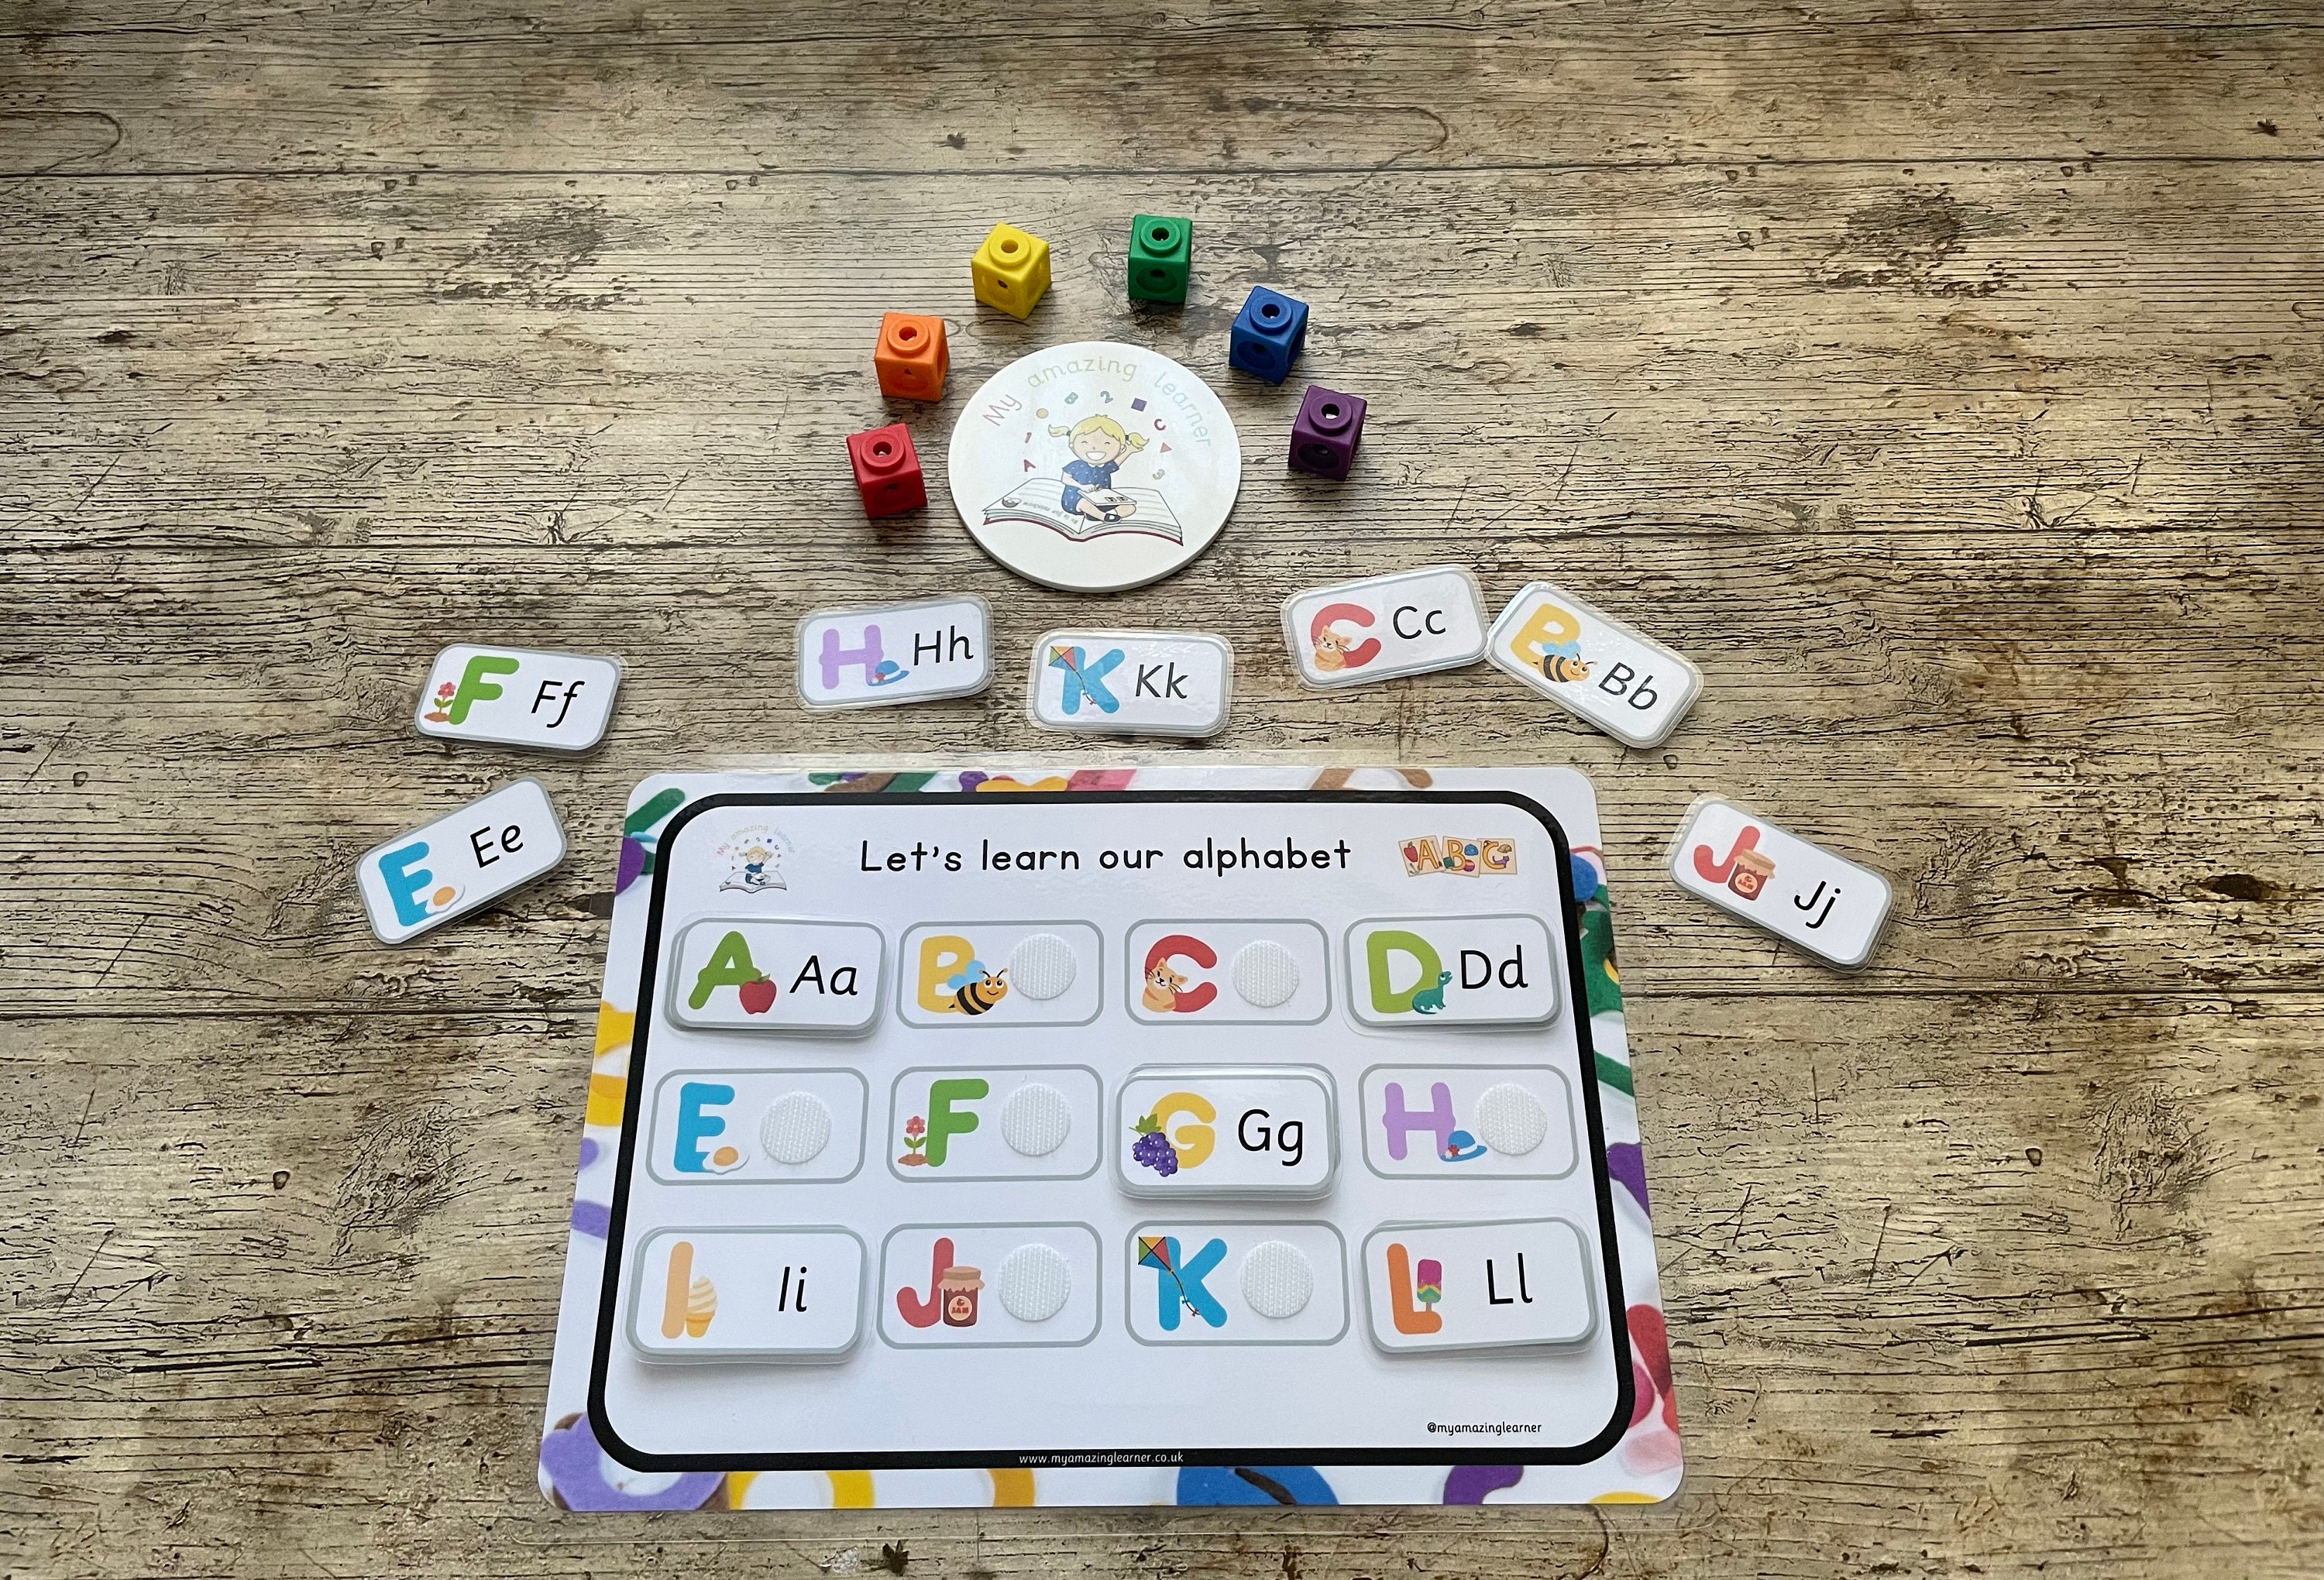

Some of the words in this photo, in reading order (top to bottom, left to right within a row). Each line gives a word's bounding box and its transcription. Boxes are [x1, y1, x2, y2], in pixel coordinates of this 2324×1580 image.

[982, 394, 1023, 426] My
[1027, 356, 1137, 387] amazing
[1154, 371, 1212, 447] learner
[1100, 391, 1114, 404] 2
[1154, 418, 1167, 431] C
[819, 624, 885, 689] H
[913, 625, 974, 666] Hh
[1310, 603, 1381, 669] C
[1392, 606, 1446, 640] Cc
[448, 655, 520, 726] F
[531, 679, 586, 729] Ff
[1061, 646, 1126, 715] K
[1135, 662, 1189, 699] Kk
[1598, 661, 1659, 710] Bb
[731, 825, 768, 840] amazing
[982, 839, 1080, 871] learn
[1099, 850, 1164, 869] our
[1183, 836, 1351, 878] alphabet
[378, 841, 433, 926] E
[469, 823, 524, 868] Ee
[1693, 826, 1761, 883] J
[1793, 881, 1841, 929] Jj
[688, 930, 761, 1010] A
[789, 954, 858, 995] Aa
[1144, 934, 1218, 1013] C
[1366, 930, 1443, 1014] D
[1459, 944, 1529, 991] Dd
[673, 1082, 735, 1173] E
[927, 1078, 990, 1167] F
[1150, 1092, 1217, 1169] G
[1237, 1108, 1305, 1166] Gg
[1382, 1082, 1456, 1161] H
[778, 1266, 808, 1313] Ii
[896, 1237, 954, 1328] J
[1159, 1236, 1228, 1331] K
[1387, 1243, 1442, 1334] L
[1485, 1252, 1534, 1305] Ll
[1019, 1451, 1184, 1466] www.myamazinglearner.co.uk
[1427, 1421, 1542, 1436] @myamazinglearner
